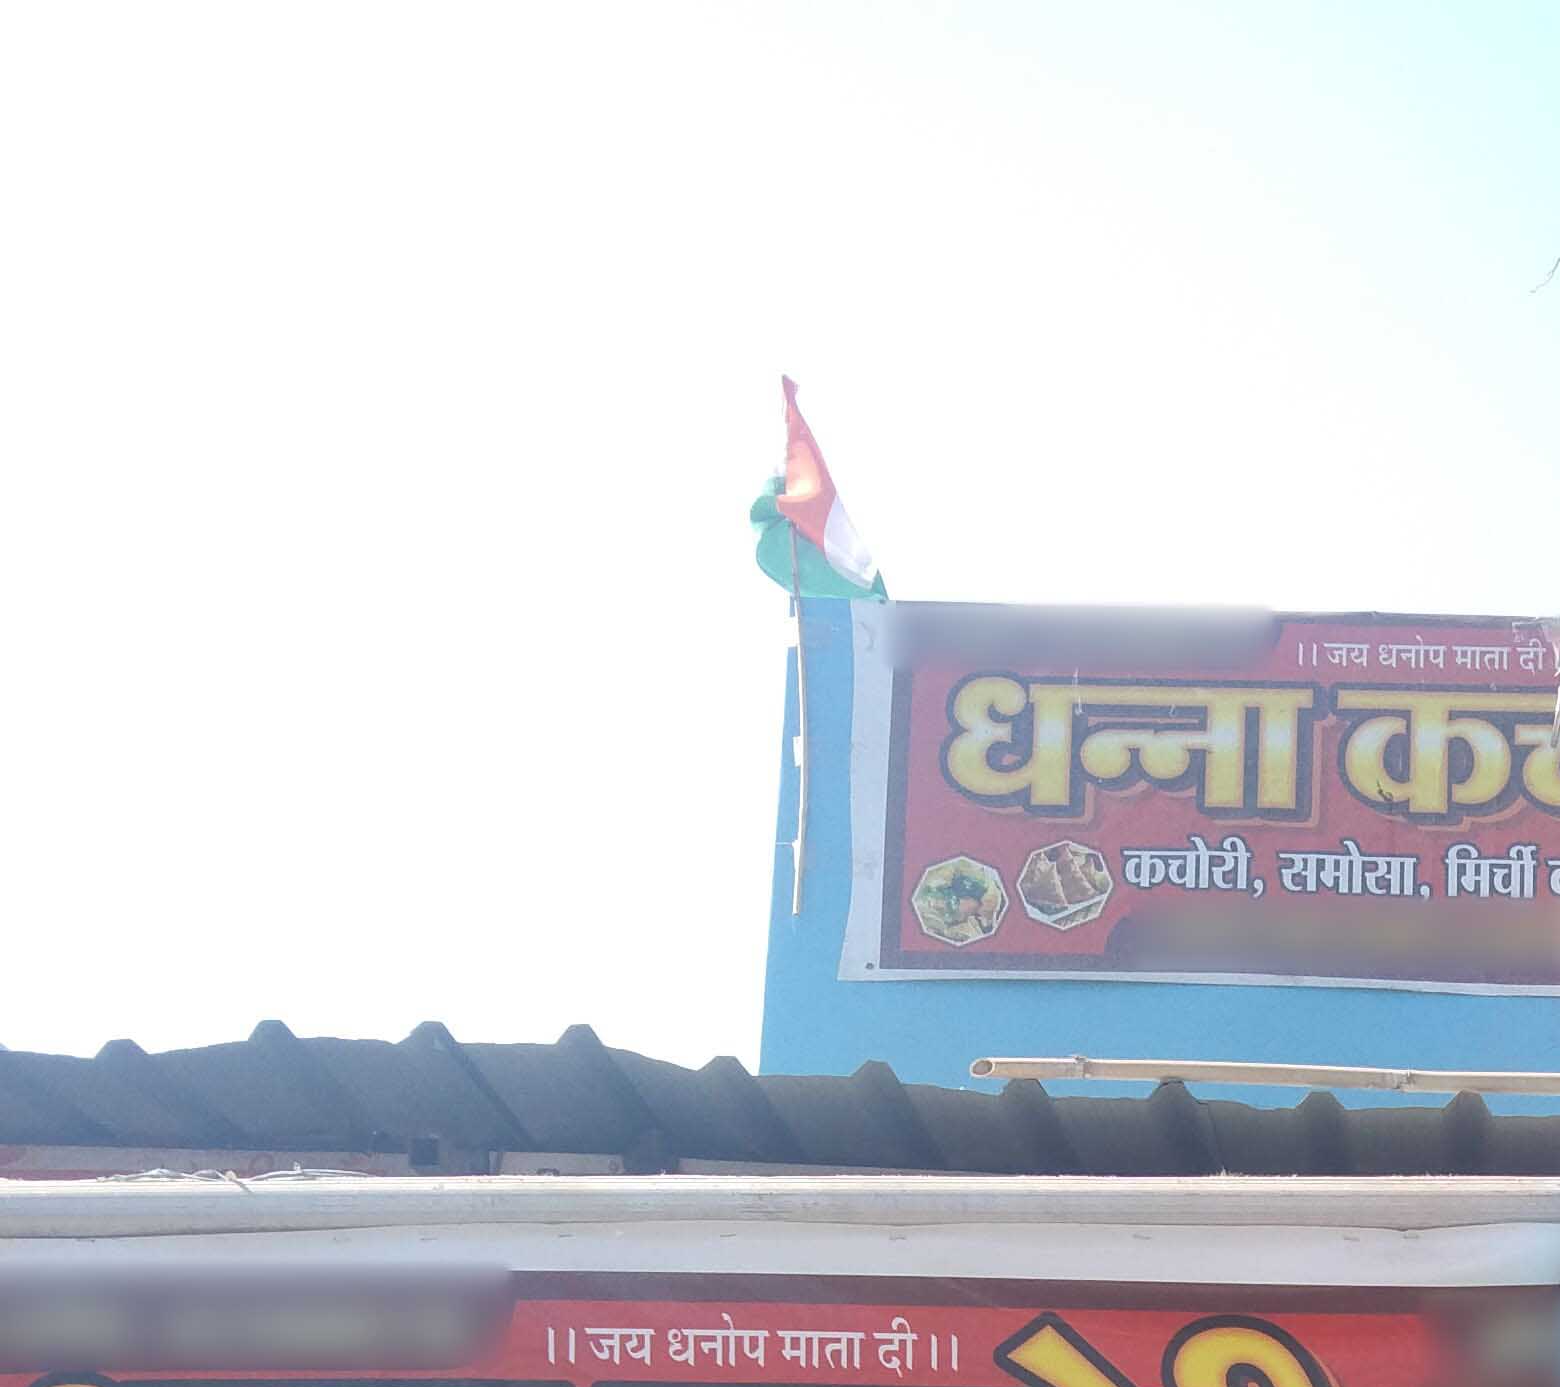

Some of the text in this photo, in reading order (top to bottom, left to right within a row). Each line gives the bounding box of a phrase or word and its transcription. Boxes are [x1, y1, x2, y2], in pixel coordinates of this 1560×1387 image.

[1327, 642, 1368, 668] जय
[1378, 637, 1446, 670] धनोप
[1453, 645, 1511, 671] माता
[1516, 638, 1547, 675] दी
[946, 677, 1314, 809] धन्ना
[1124, 836, 1265, 897] कचोरी,
[1280, 841, 1431, 901] समोसा,
[1446, 844, 1537, 898] मिर्ची
[586, 1327, 654, 1367] जय
[666, 1313, 765, 1369] धनोप
[780, 1329, 865, 1369] माता
[875, 1318, 919, 1374] दी
